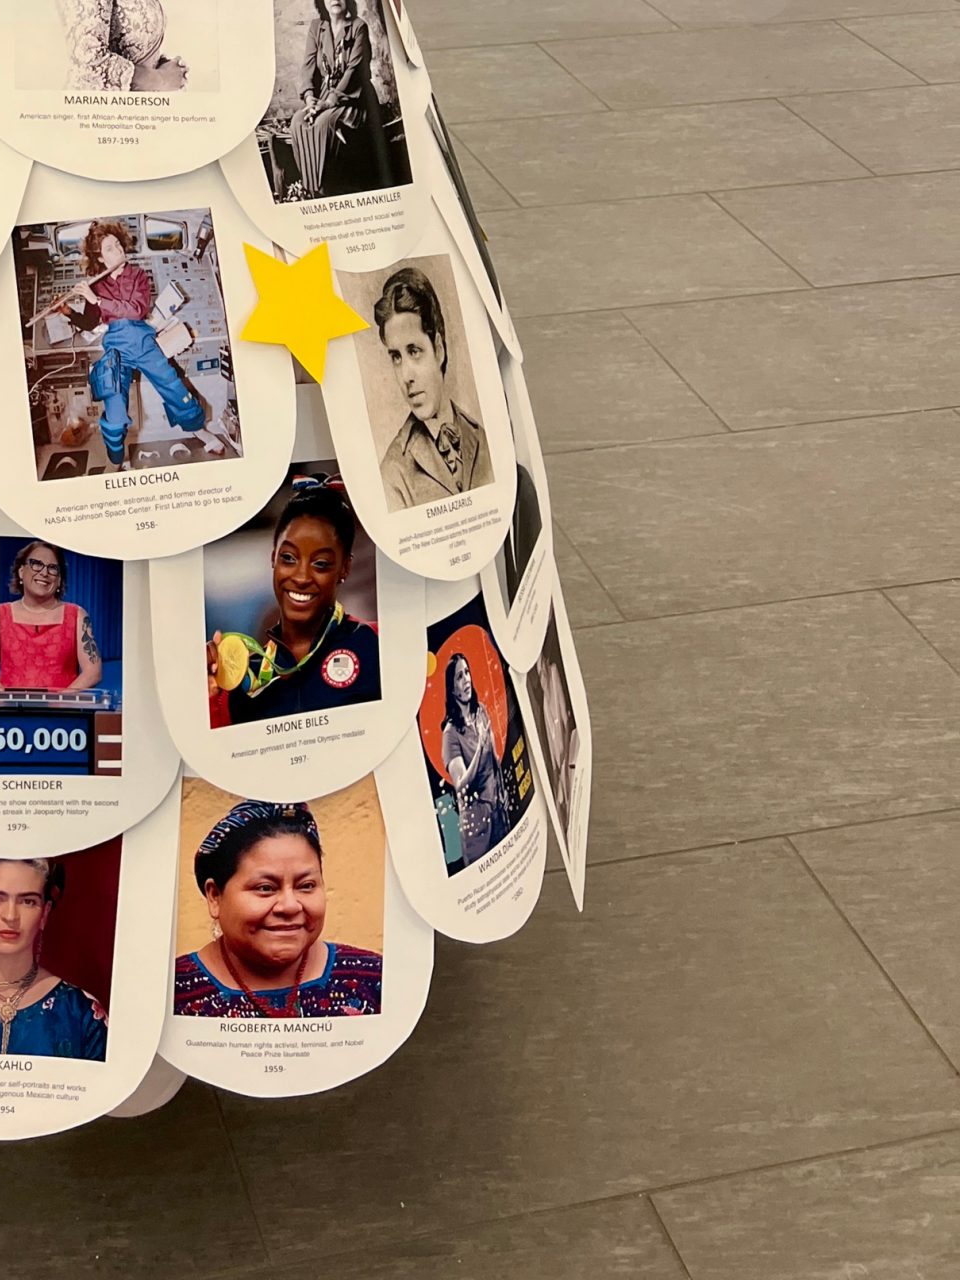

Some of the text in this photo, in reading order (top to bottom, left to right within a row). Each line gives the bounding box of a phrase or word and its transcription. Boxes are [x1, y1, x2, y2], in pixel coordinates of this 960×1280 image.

[64, 95, 170, 106] MARIAN ANDERSON
[97, 137, 139, 145] 1897-1993
[300, 192, 401, 216] WILMA PEARL MANKILLER
[105, 471, 180, 490] ELLEN OCHOA
[56, 504, 89, 514] American
[159, 492, 172, 501] and
[426, 504, 448, 519] EMMA
[266, 715, 329, 735] SIMONE BILES
[2, 780, 63, 790] SCHNEIDER
[478, 849, 503, 873] WANDA
[220, 1022, 281, 1033] RIGOBERTA
